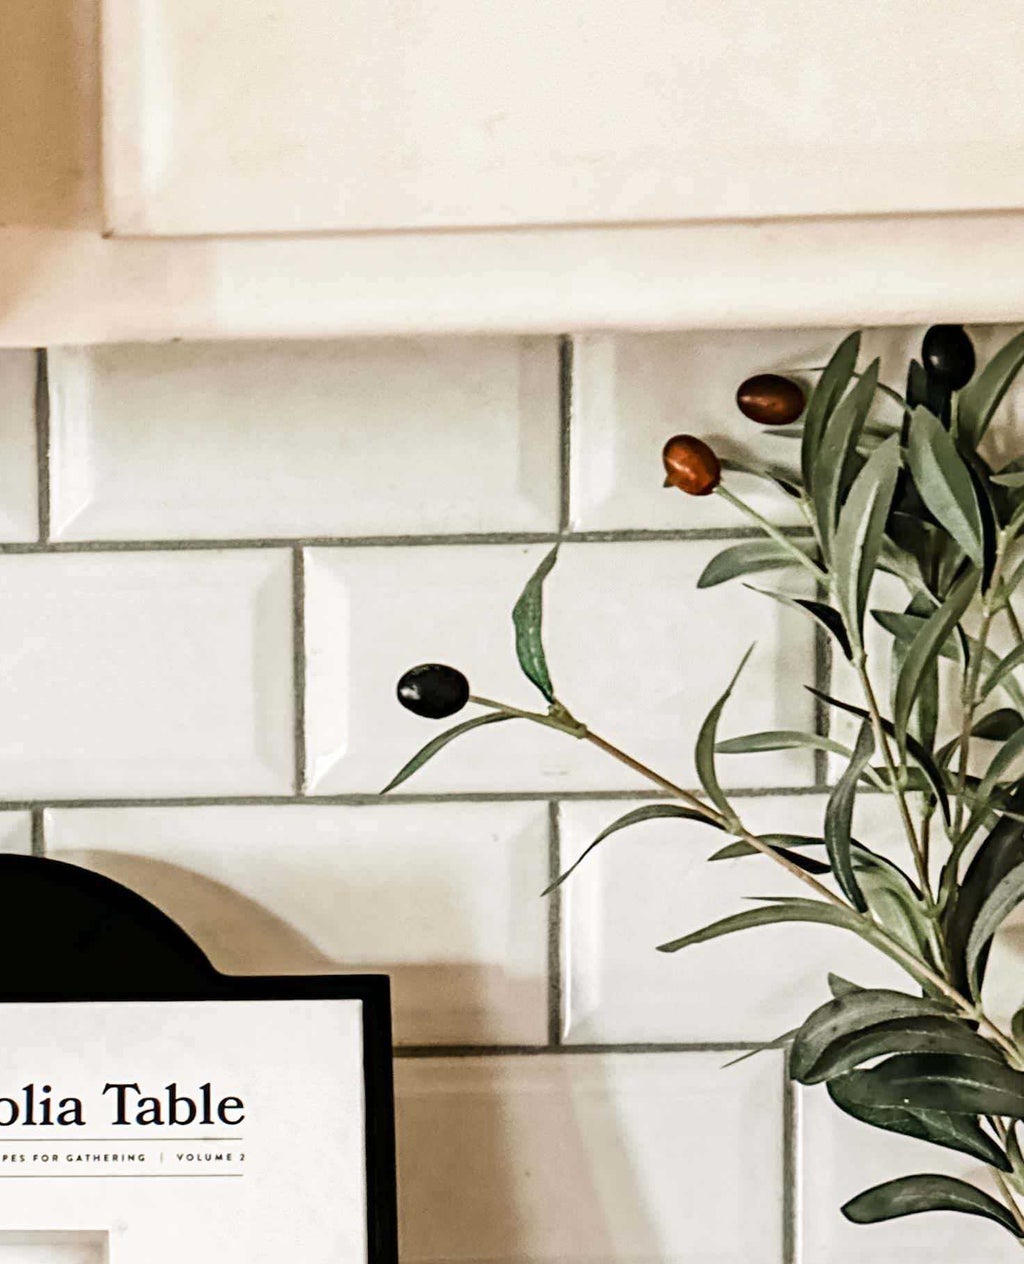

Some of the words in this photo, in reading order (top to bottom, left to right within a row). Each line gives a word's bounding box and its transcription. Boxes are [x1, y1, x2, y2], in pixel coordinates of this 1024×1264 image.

[102, 1083, 246, 1126] Table
[33, 1154, 59, 1162] FOR
[66, 1153, 146, 1162] GATHERING
[176, 1153, 233, 1162] VOLUME
[239, 1153, 246, 1162] 2
